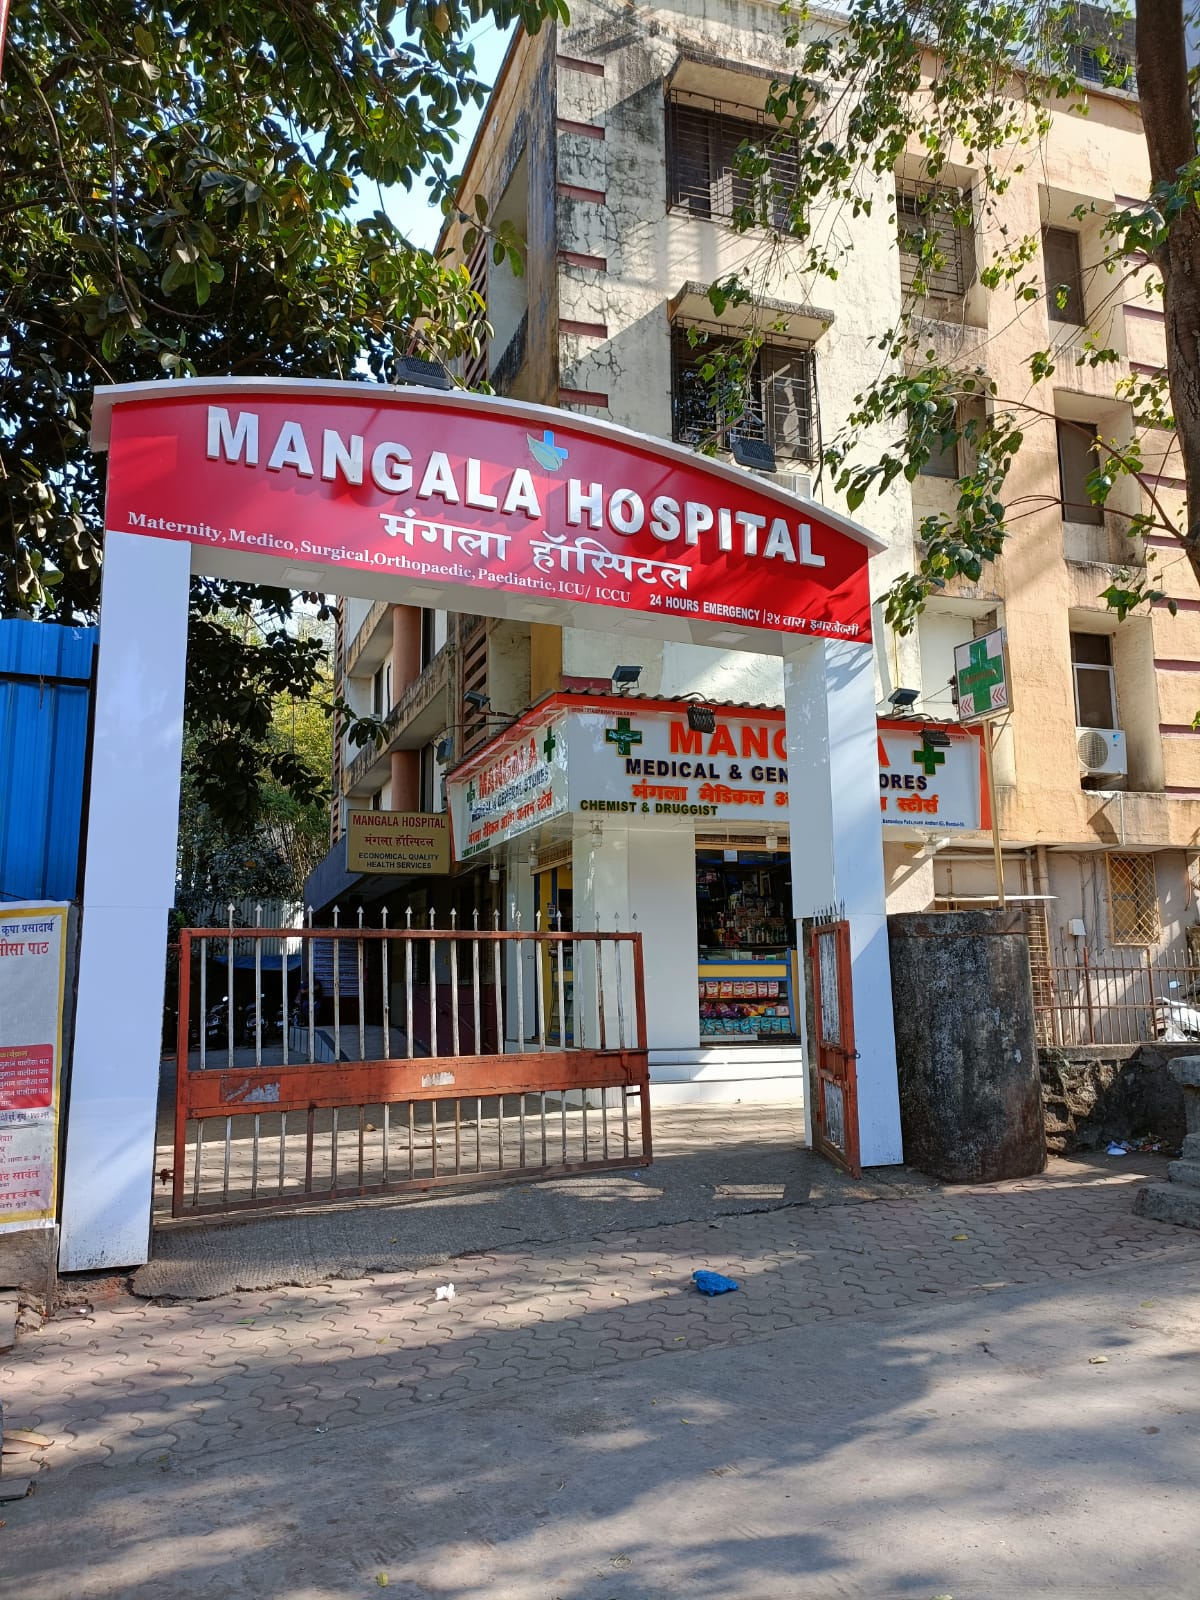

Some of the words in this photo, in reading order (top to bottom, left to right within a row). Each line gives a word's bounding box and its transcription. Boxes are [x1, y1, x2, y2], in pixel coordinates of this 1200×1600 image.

[206, 405, 543, 520] MANGALA
[566, 478, 827, 568] HOSPITAL
[128, 511, 226, 543] Maternity,
[228, 527, 299, 555] Medico,
[300, 540, 374, 565] Surgical,
[374, 552, 476, 580] Orthopaedic,
[477, 567, 556, 592] Paediatric,
[558, 580, 592, 600] ICU/
[596, 586, 631, 603] ICCU
[379, 508, 512, 562] मंगला
[529, 530, 692, 591] हॉस्पिटल
[649, 593, 662, 607] 24
[665, 595, 699, 613] HOURS
[703, 601, 760, 621] EMERGENCY
[767, 612, 781, 625] २४
[782, 615, 806, 629] तास
[625, 758, 720, 779] MEDICAL
[729, 764, 743, 780] &
[631, 778, 689, 801] मंगला
[698, 782, 765, 805] मेडिकल
[580, 799, 637, 812] CHEMIST
[642, 801, 650, 813] &
[655, 803, 719, 816] DRUGGIST
[896, 793, 939, 814] स्टोर्स
[352, 814, 399, 826] MANGALA
[402, 816, 445, 829] HOSPITAL
[364, 833, 393, 846] मंगला
[396, 834, 434, 847] हॉस्पिटल
[358, 852, 407, 860] ECONOMICAL
[408, 853, 439, 861] QUALITY
[1, 924, 20, 937] कृपा
[28, 942, 49, 955] पाठ
[12, 1169, 40, 1180] सावंत
